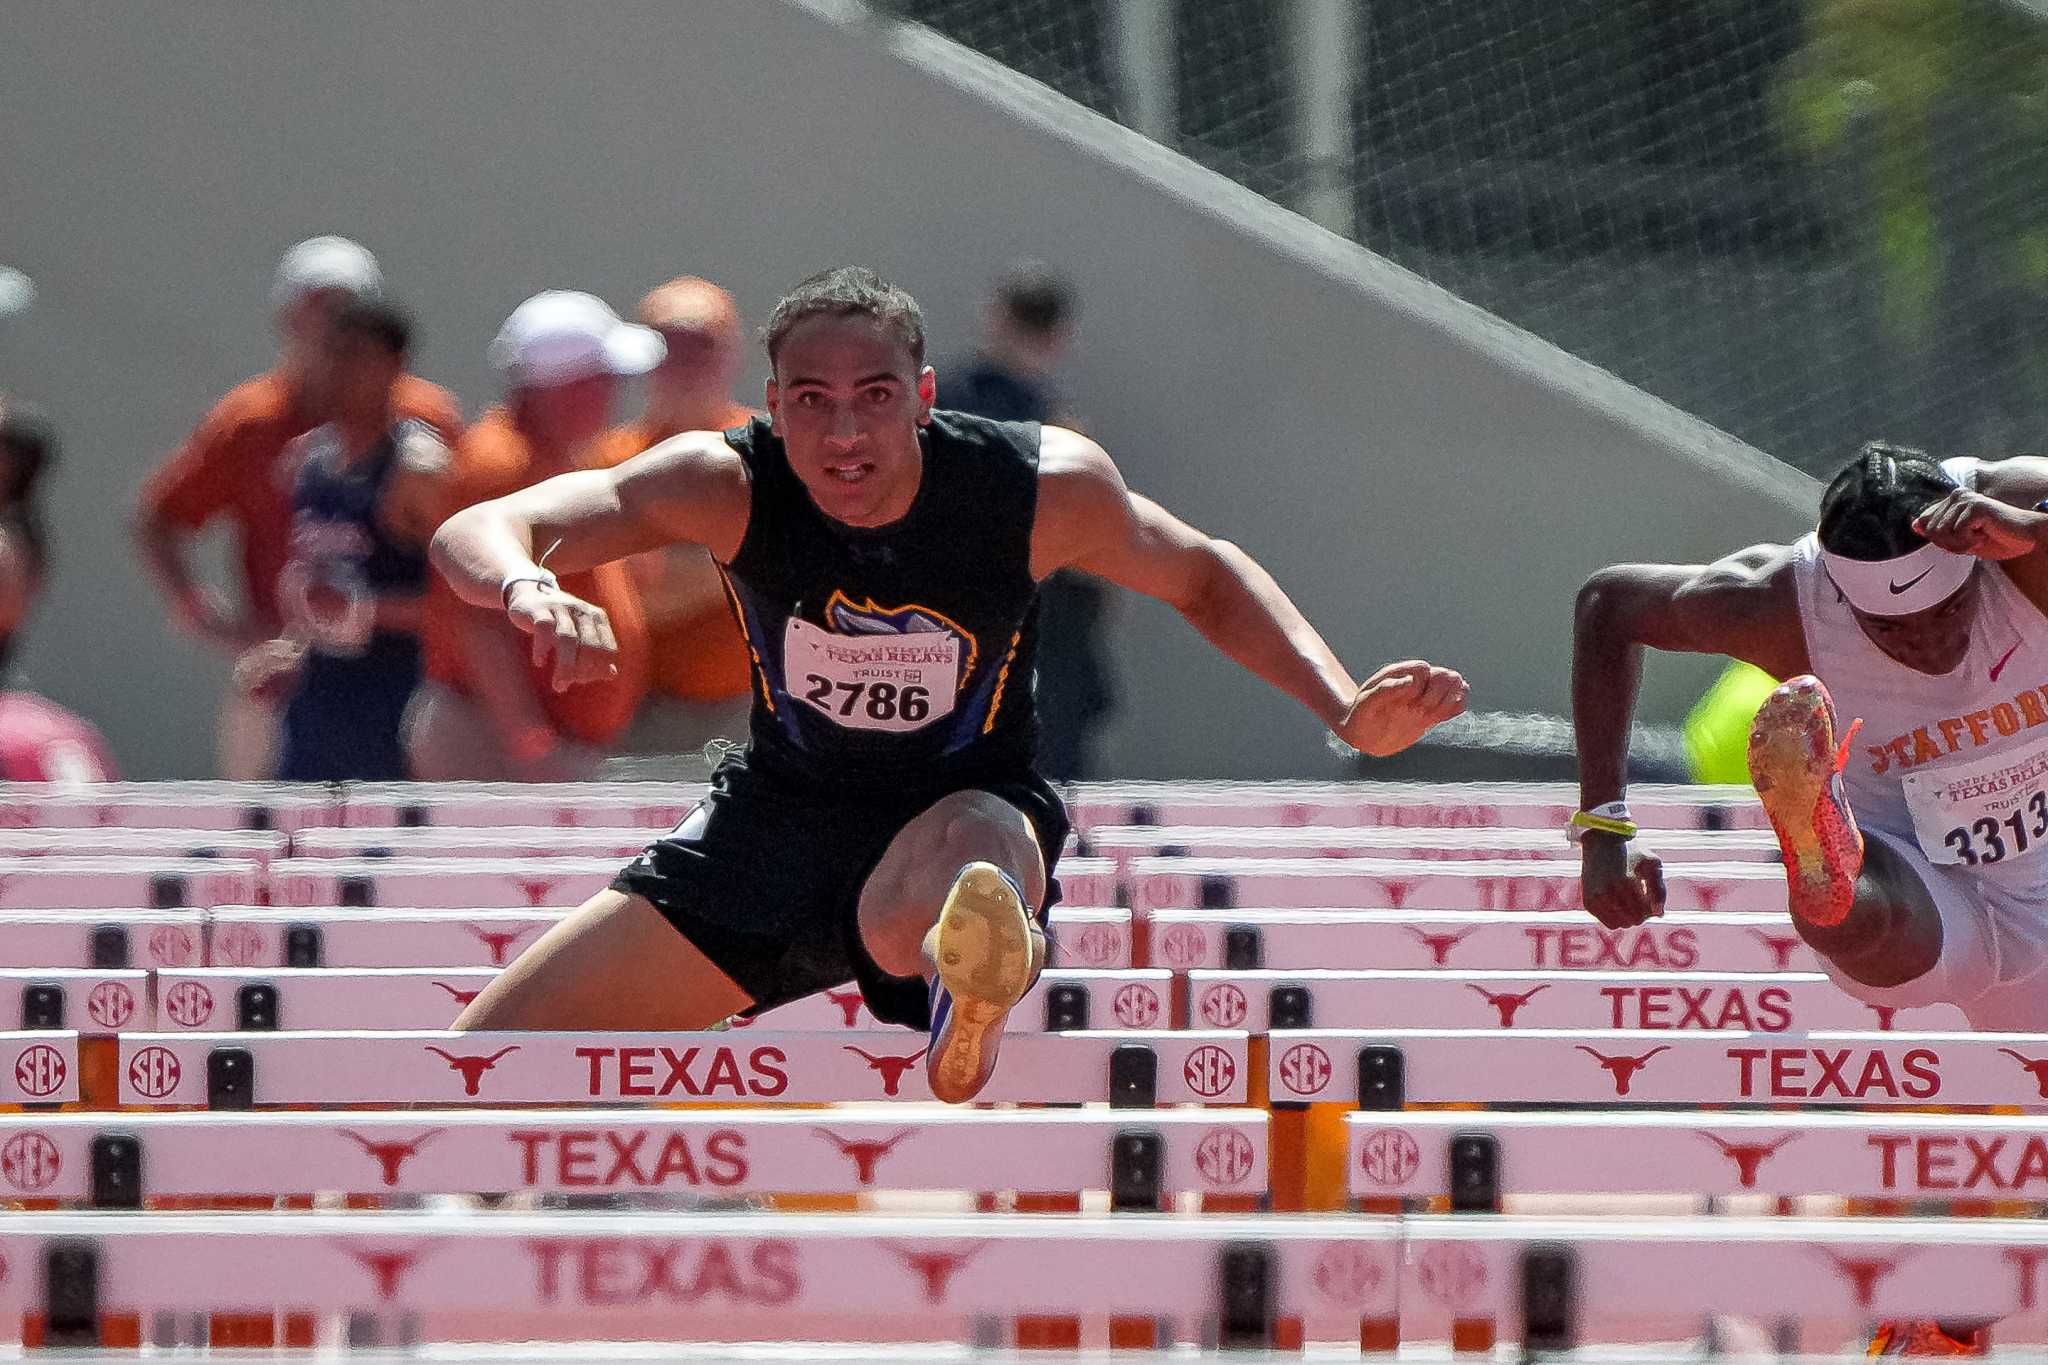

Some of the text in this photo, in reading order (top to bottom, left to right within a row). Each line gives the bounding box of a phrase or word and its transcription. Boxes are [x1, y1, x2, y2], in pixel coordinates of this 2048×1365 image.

[805, 674, 930, 722] 2786
[852, 669, 900, 678] TRUIST
[1949, 777, 2008, 801] TEXAS
[1944, 790, 2048, 865] 3313
[1524, 926, 1698, 970] TEXAS
[1600, 986, 1793, 1033] TEXAS
[15, 1044, 67, 1096] SEC
[129, 1046, 181, 1098] SEC
[575, 1046, 789, 1097] TEXAS
[1183, 1045, 1236, 1097] SEC
[1279, 1043, 1332, 1095] SEC
[1726, 1048, 1942, 1099] TEXAS
[509, 1129, 749, 1187] TEXAS
[524, 1238, 804, 1305] TEXAS
